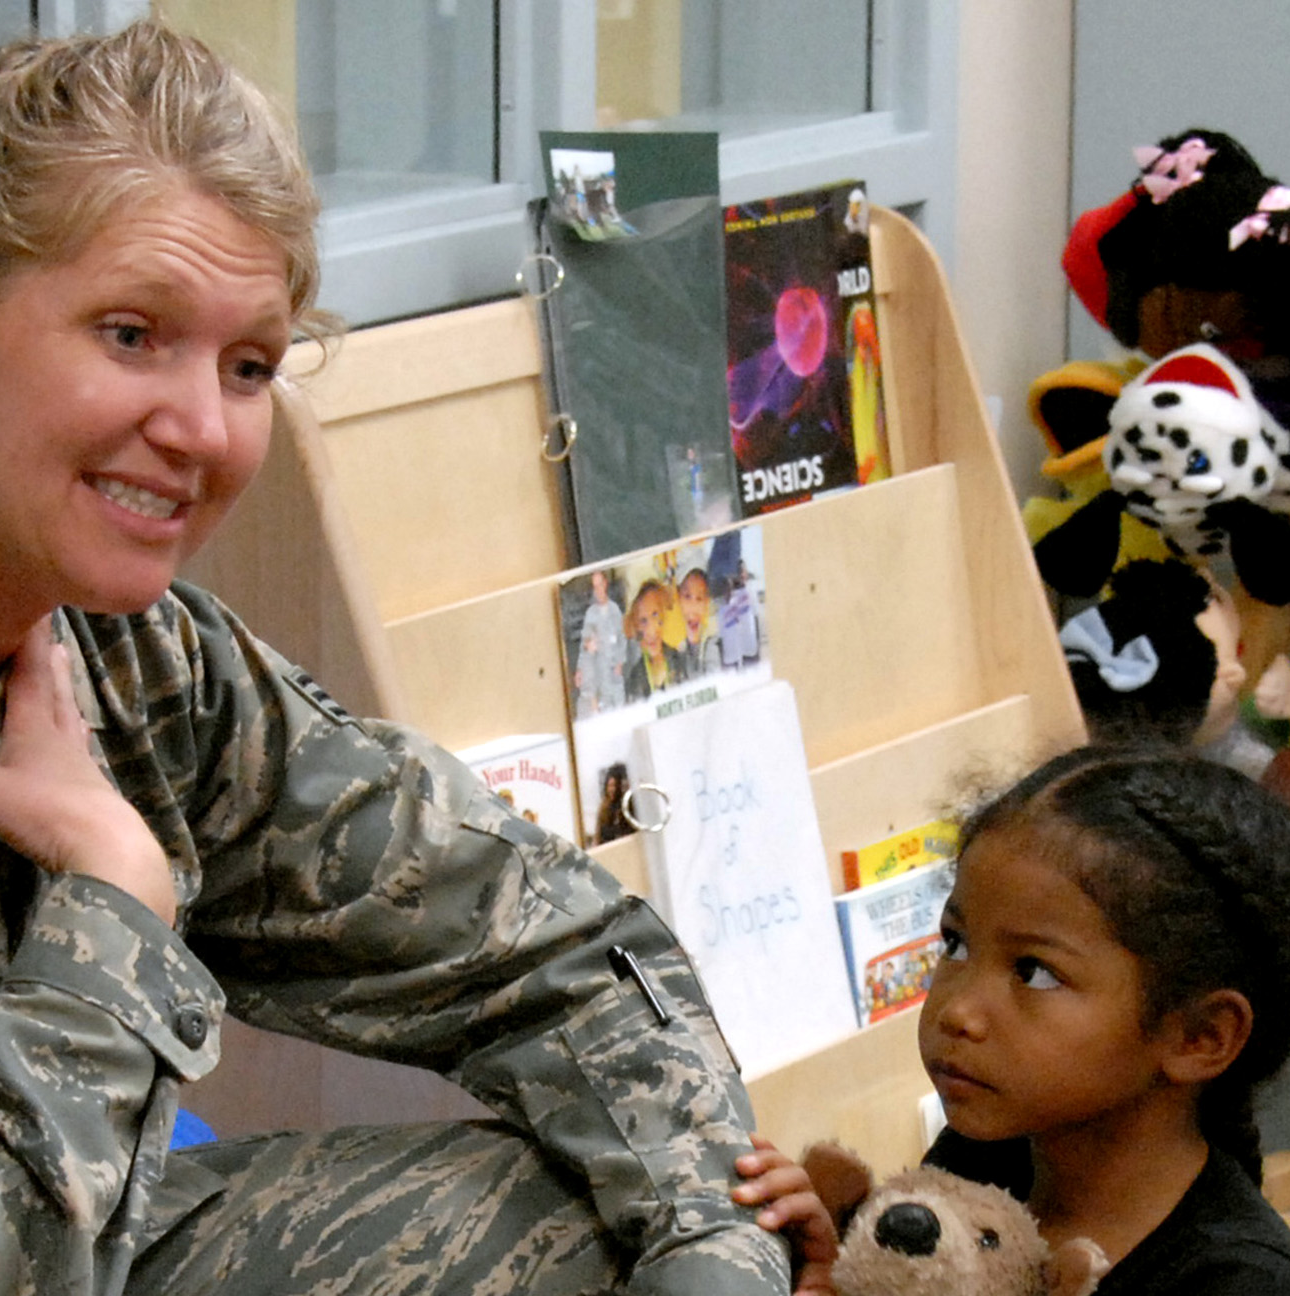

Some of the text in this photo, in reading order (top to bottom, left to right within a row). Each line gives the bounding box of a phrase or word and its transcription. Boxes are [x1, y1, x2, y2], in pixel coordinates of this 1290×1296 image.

[741, 454, 825, 503] SCIENCE
[481, 758, 563, 790] Your Hands
[691, 758, 763, 823] Book
[699, 883, 802, 956] Shapes
